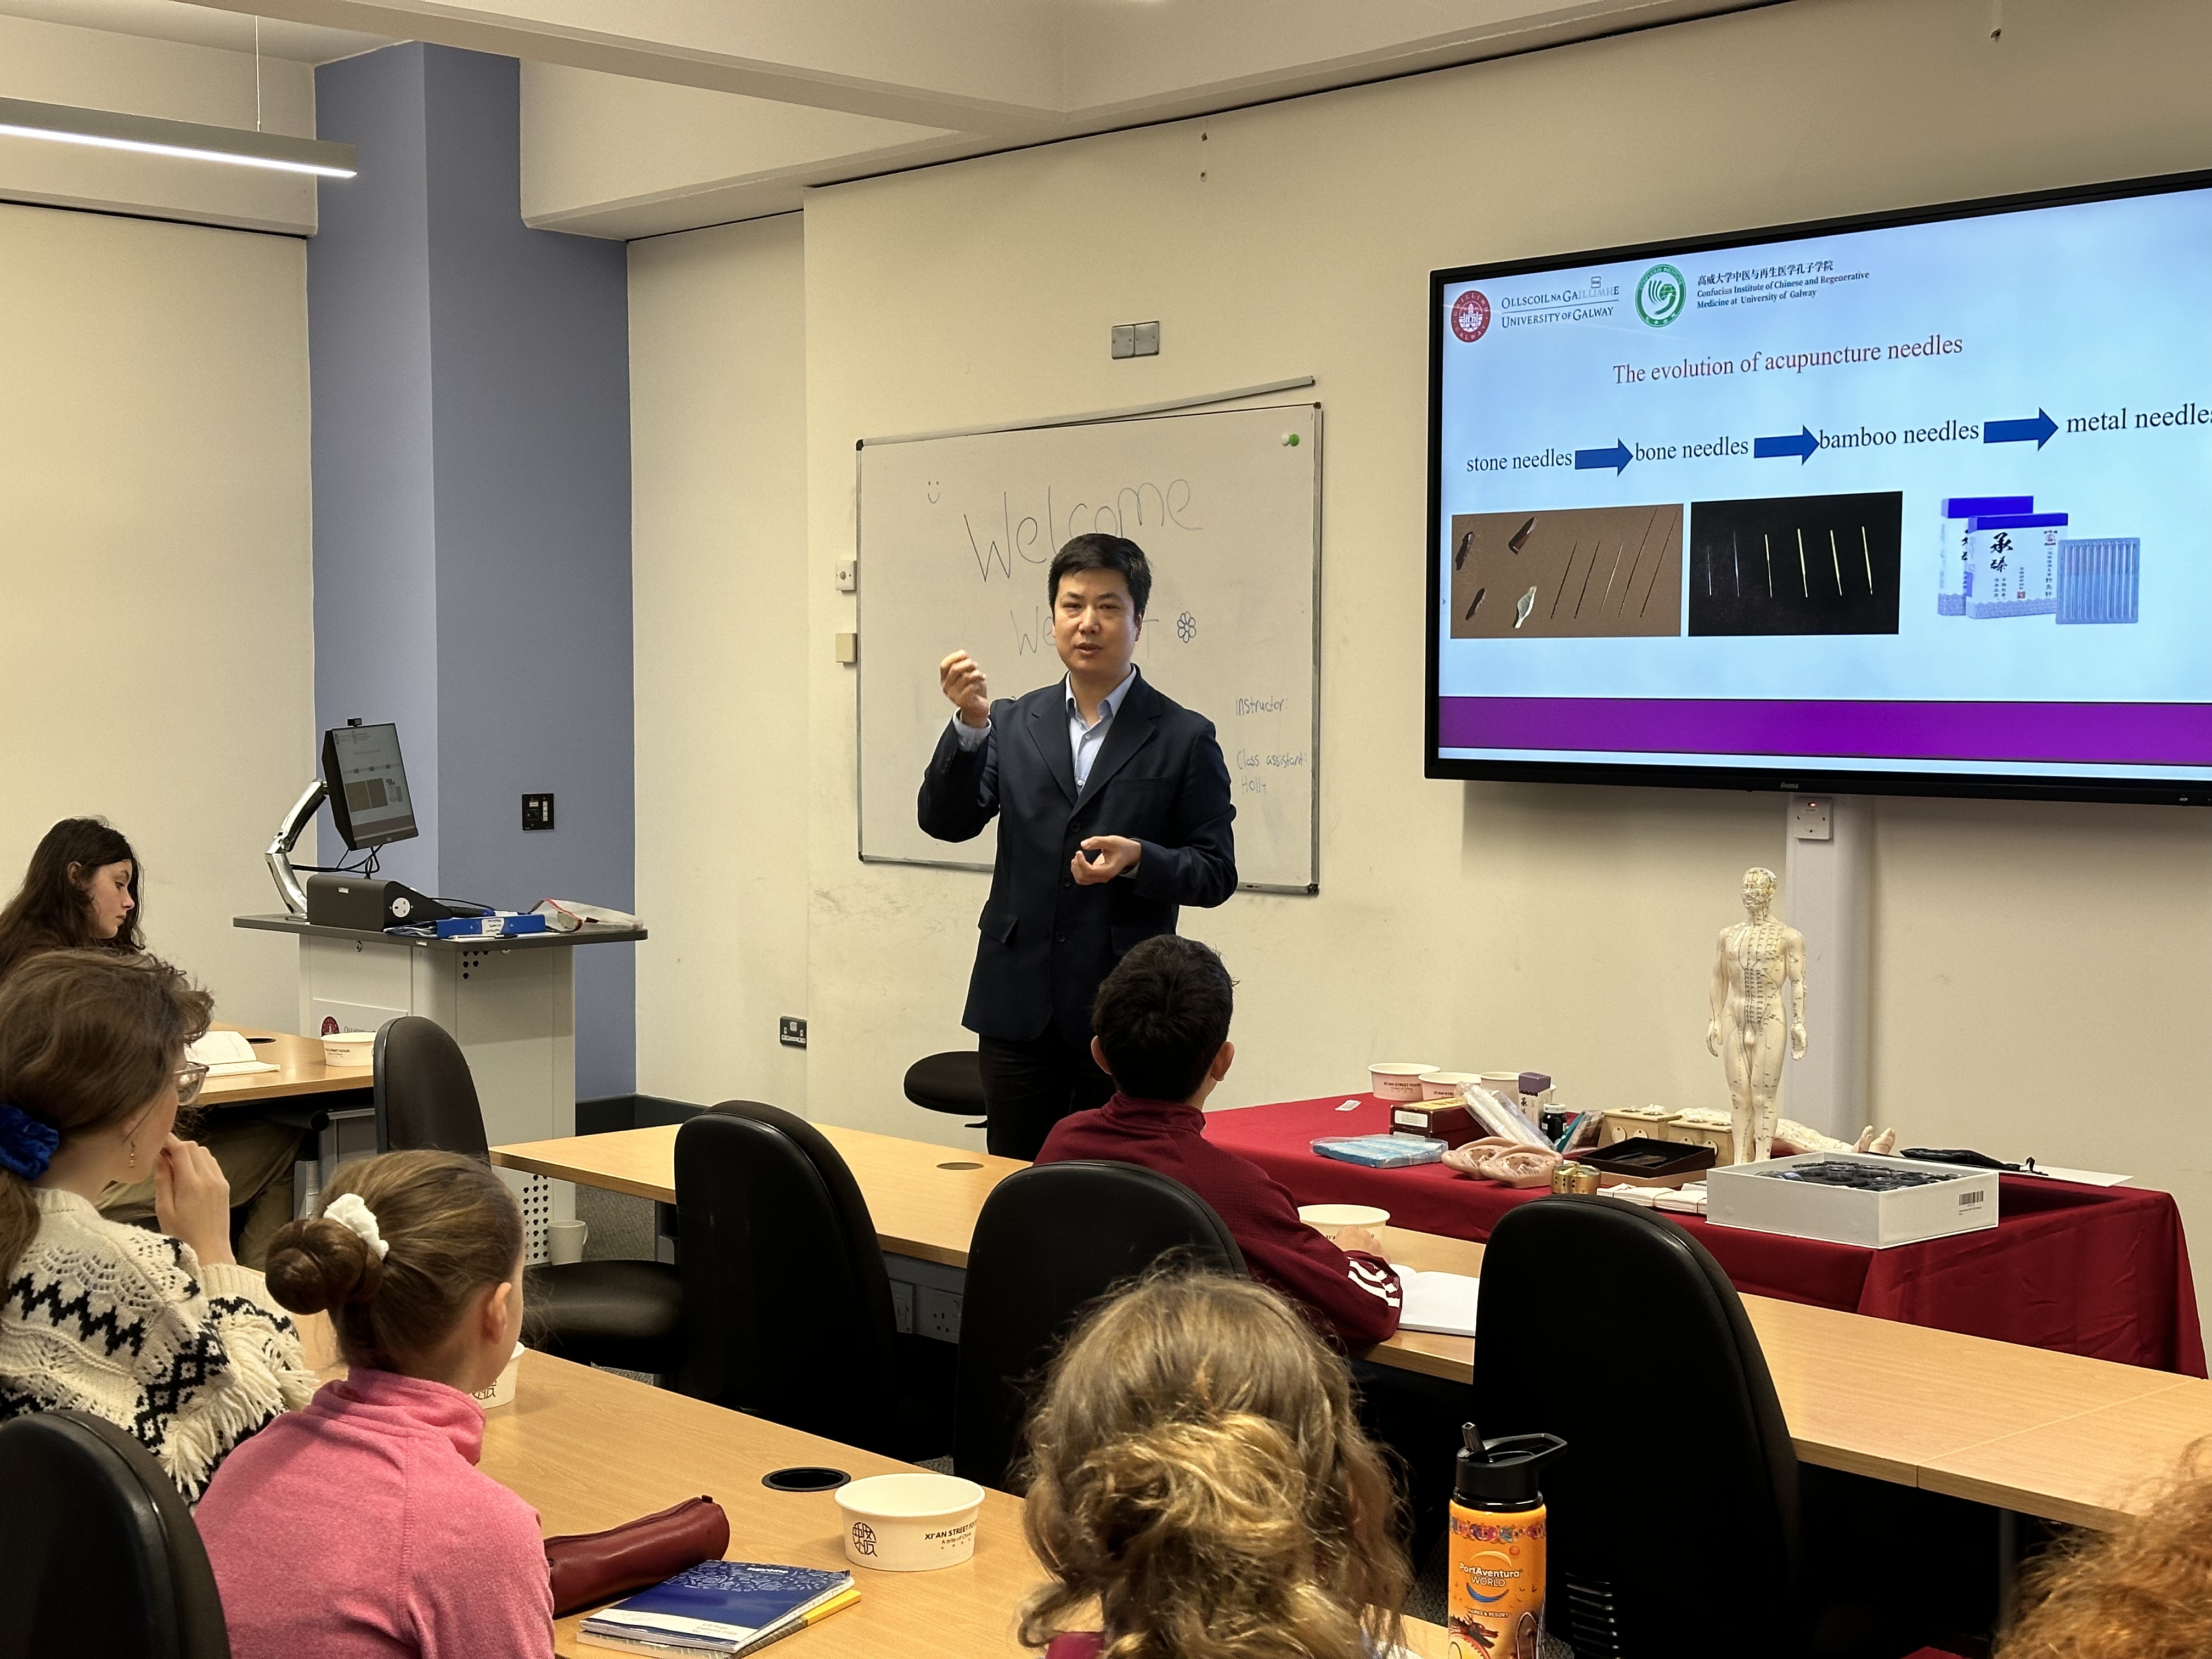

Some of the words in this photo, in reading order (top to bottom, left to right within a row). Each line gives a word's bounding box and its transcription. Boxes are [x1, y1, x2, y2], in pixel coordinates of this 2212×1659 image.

[1734, 284, 1764, 294] Institute
[1765, 280, 1774, 290] of
[1774, 279, 1803, 289] Chinese
[1804, 276, 1819, 285] and
[1820, 271, 1870, 284] Regenerative
[1502, 294, 1550, 309] OLLSCOIL
[1551, 292, 1561, 301] NA
[1563, 286, 1619, 302] GAILLIMHE
[1697, 298, 1729, 309] Medicine
[1741, 292, 1778, 303] University
[1779, 291, 1788, 300] of
[1790, 289, 1817, 298] Galway
[1502, 313, 1560, 328] UNIVERSITY
[1573, 307, 1614, 321] GALWAY
[1613, 363, 1646, 385] The
[1651, 356, 1734, 381] evolution
[1740, 351, 1762, 373] of
[1765, 346, 1882, 374] acupuncture
[1887, 334, 1963, 360] needles
[2066, 407, 2127, 433] metal
[2134, 403, 2212, 429] needle
[1819, 426, 1897, 450] bamboo
[1903, 419, 1980, 444] needles
[1466, 454, 1508, 472] stone
[1512, 448, 1572, 470] needles
[1635, 442, 1677, 461] bone
[1681, 436, 1749, 459] needles
[963, 478, 1204, 583] Welcome
[1237, 748, 1260, 770] Class
[948, 1524, 968, 1537] STREET
[1459, 1562, 1520, 1578] PortAventura
[1471, 1576, 1506, 1587] WORLD
